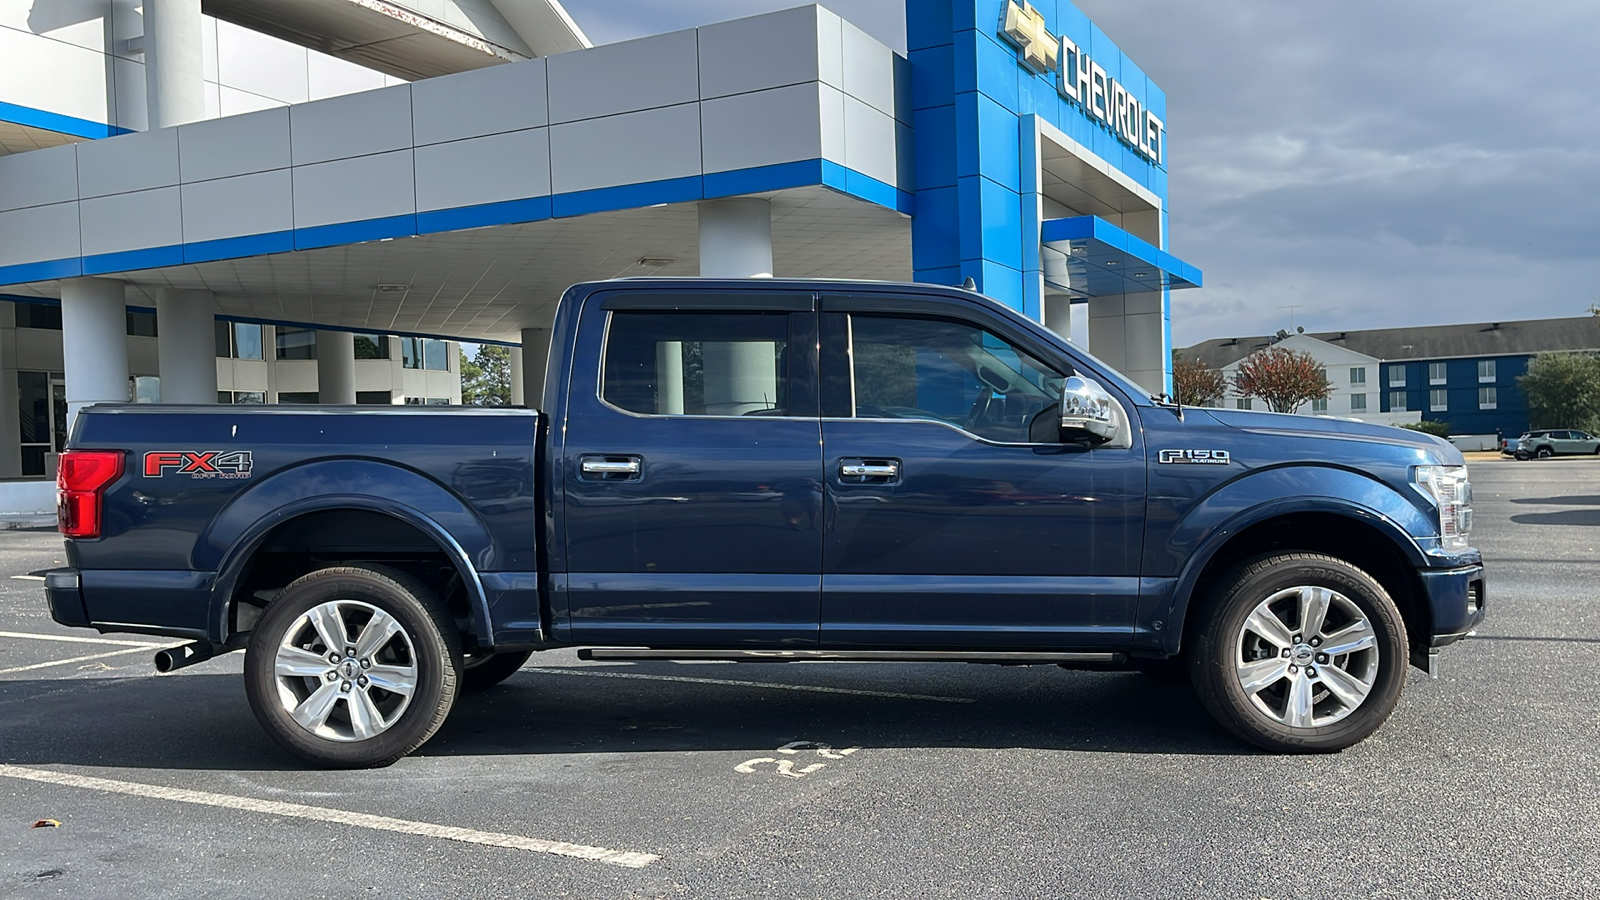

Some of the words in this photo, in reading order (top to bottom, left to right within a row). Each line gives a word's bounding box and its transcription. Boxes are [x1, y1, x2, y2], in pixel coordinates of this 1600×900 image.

[1060, 35, 1164, 165] CHEVROLET
[143, 451, 253, 478] FX4
[1159, 449, 1229, 464] F150
